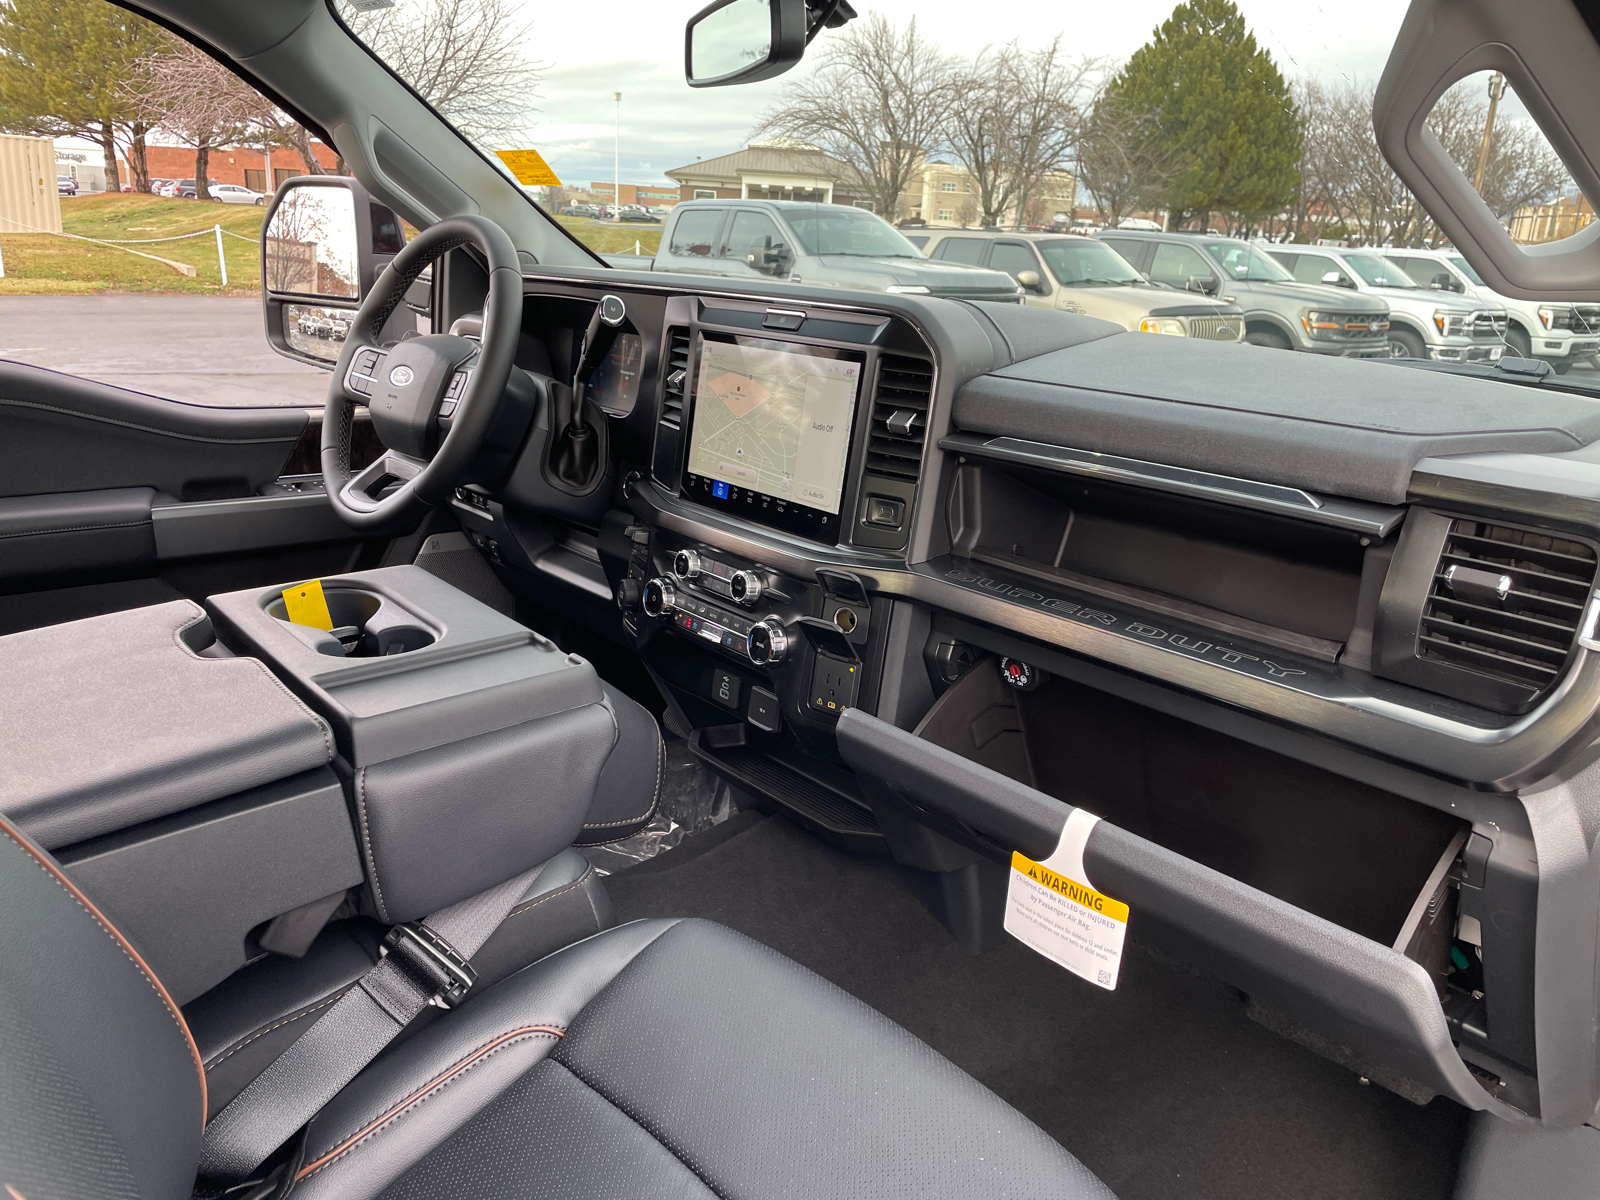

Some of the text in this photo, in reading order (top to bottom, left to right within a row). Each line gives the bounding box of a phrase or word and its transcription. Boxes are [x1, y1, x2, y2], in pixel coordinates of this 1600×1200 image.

[54, 151, 86, 163] Storage
[812, 422, 825, 432] Audio
[945, 569, 1306, 677] SUPER DUTY
[1016, 874, 1037, 891] Children
[1038, 888, 1048, 898] Can
[1050, 894, 1057, 902] Be
[1058, 898, 1078, 912] KILLED
[1088, 912, 1116, 929] INJURED
[1041, 870, 1103, 911] WARNING
[1031, 894, 1090, 931] by Passenger Air Bag.
